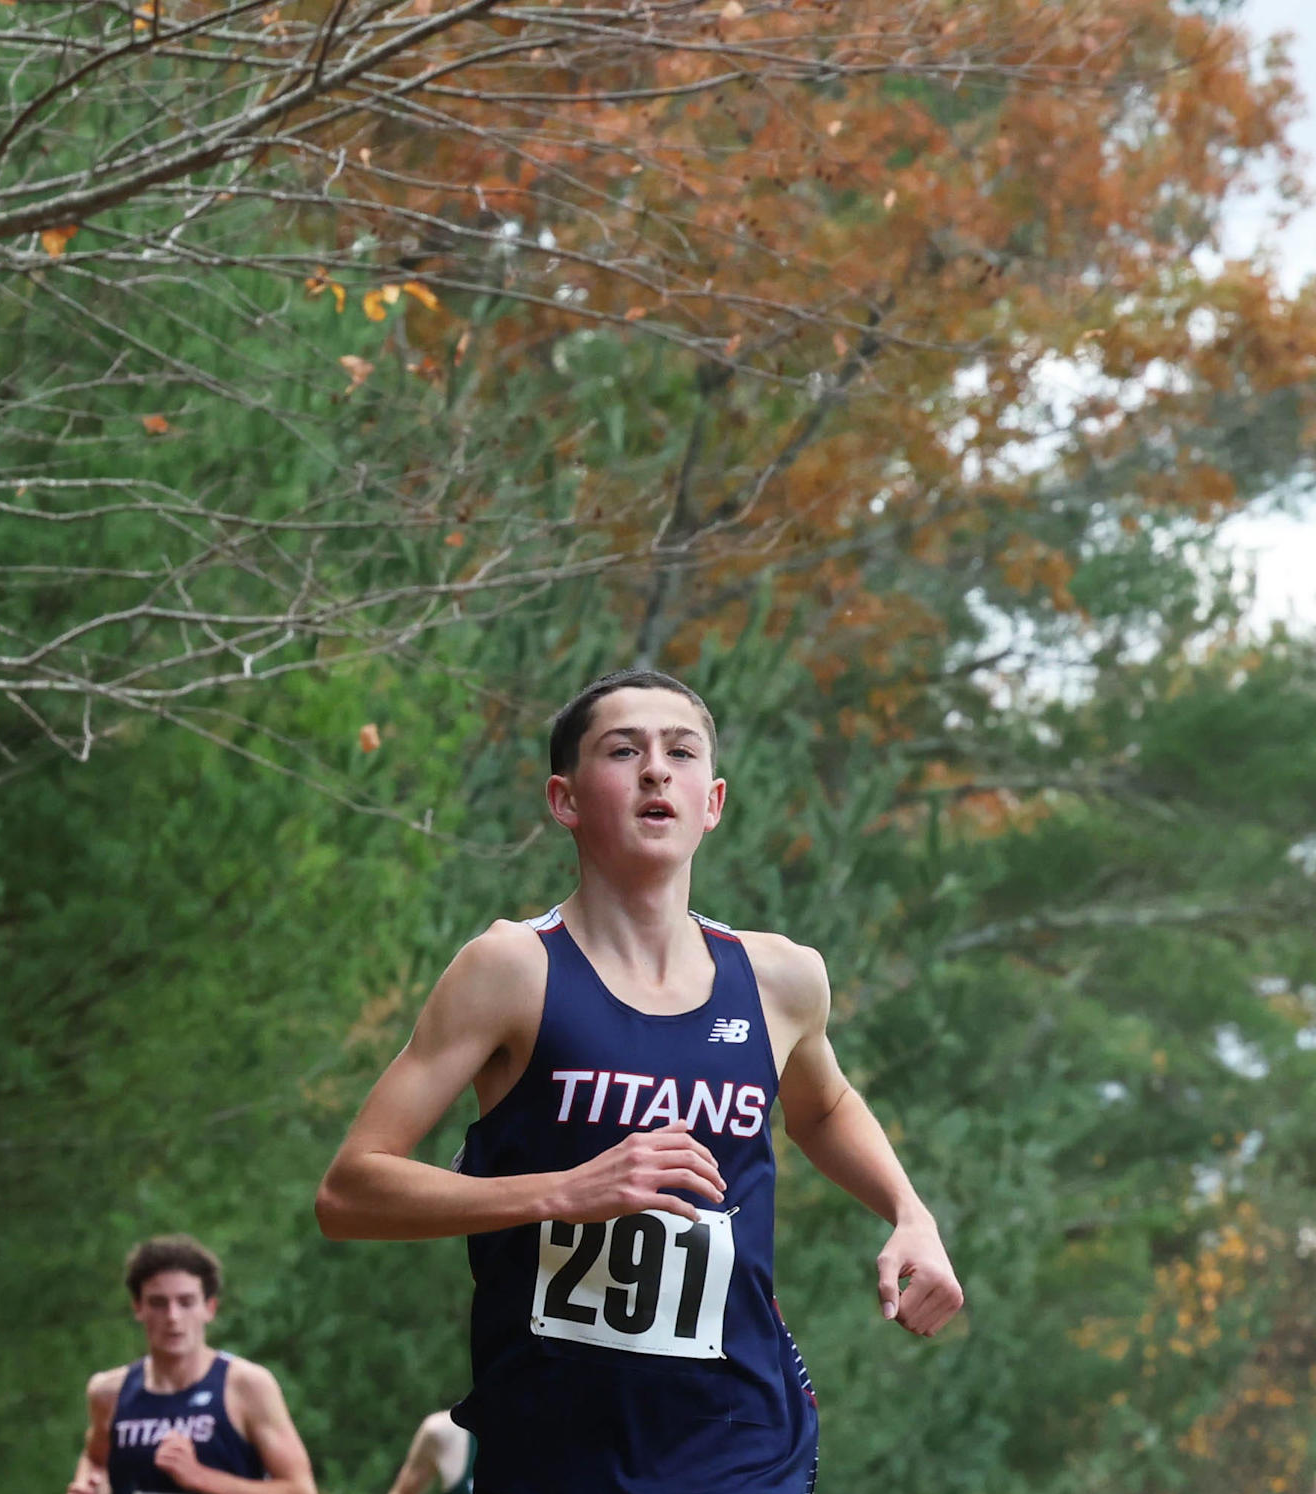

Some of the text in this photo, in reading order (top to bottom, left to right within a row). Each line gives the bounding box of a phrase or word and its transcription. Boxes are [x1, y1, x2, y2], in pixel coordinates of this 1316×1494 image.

[708, 1018, 750, 1044] NB
[551, 1069, 766, 1139] TITANS
[543, 1214, 710, 1338] 291
[115, 1414, 215, 1447] TITANS
